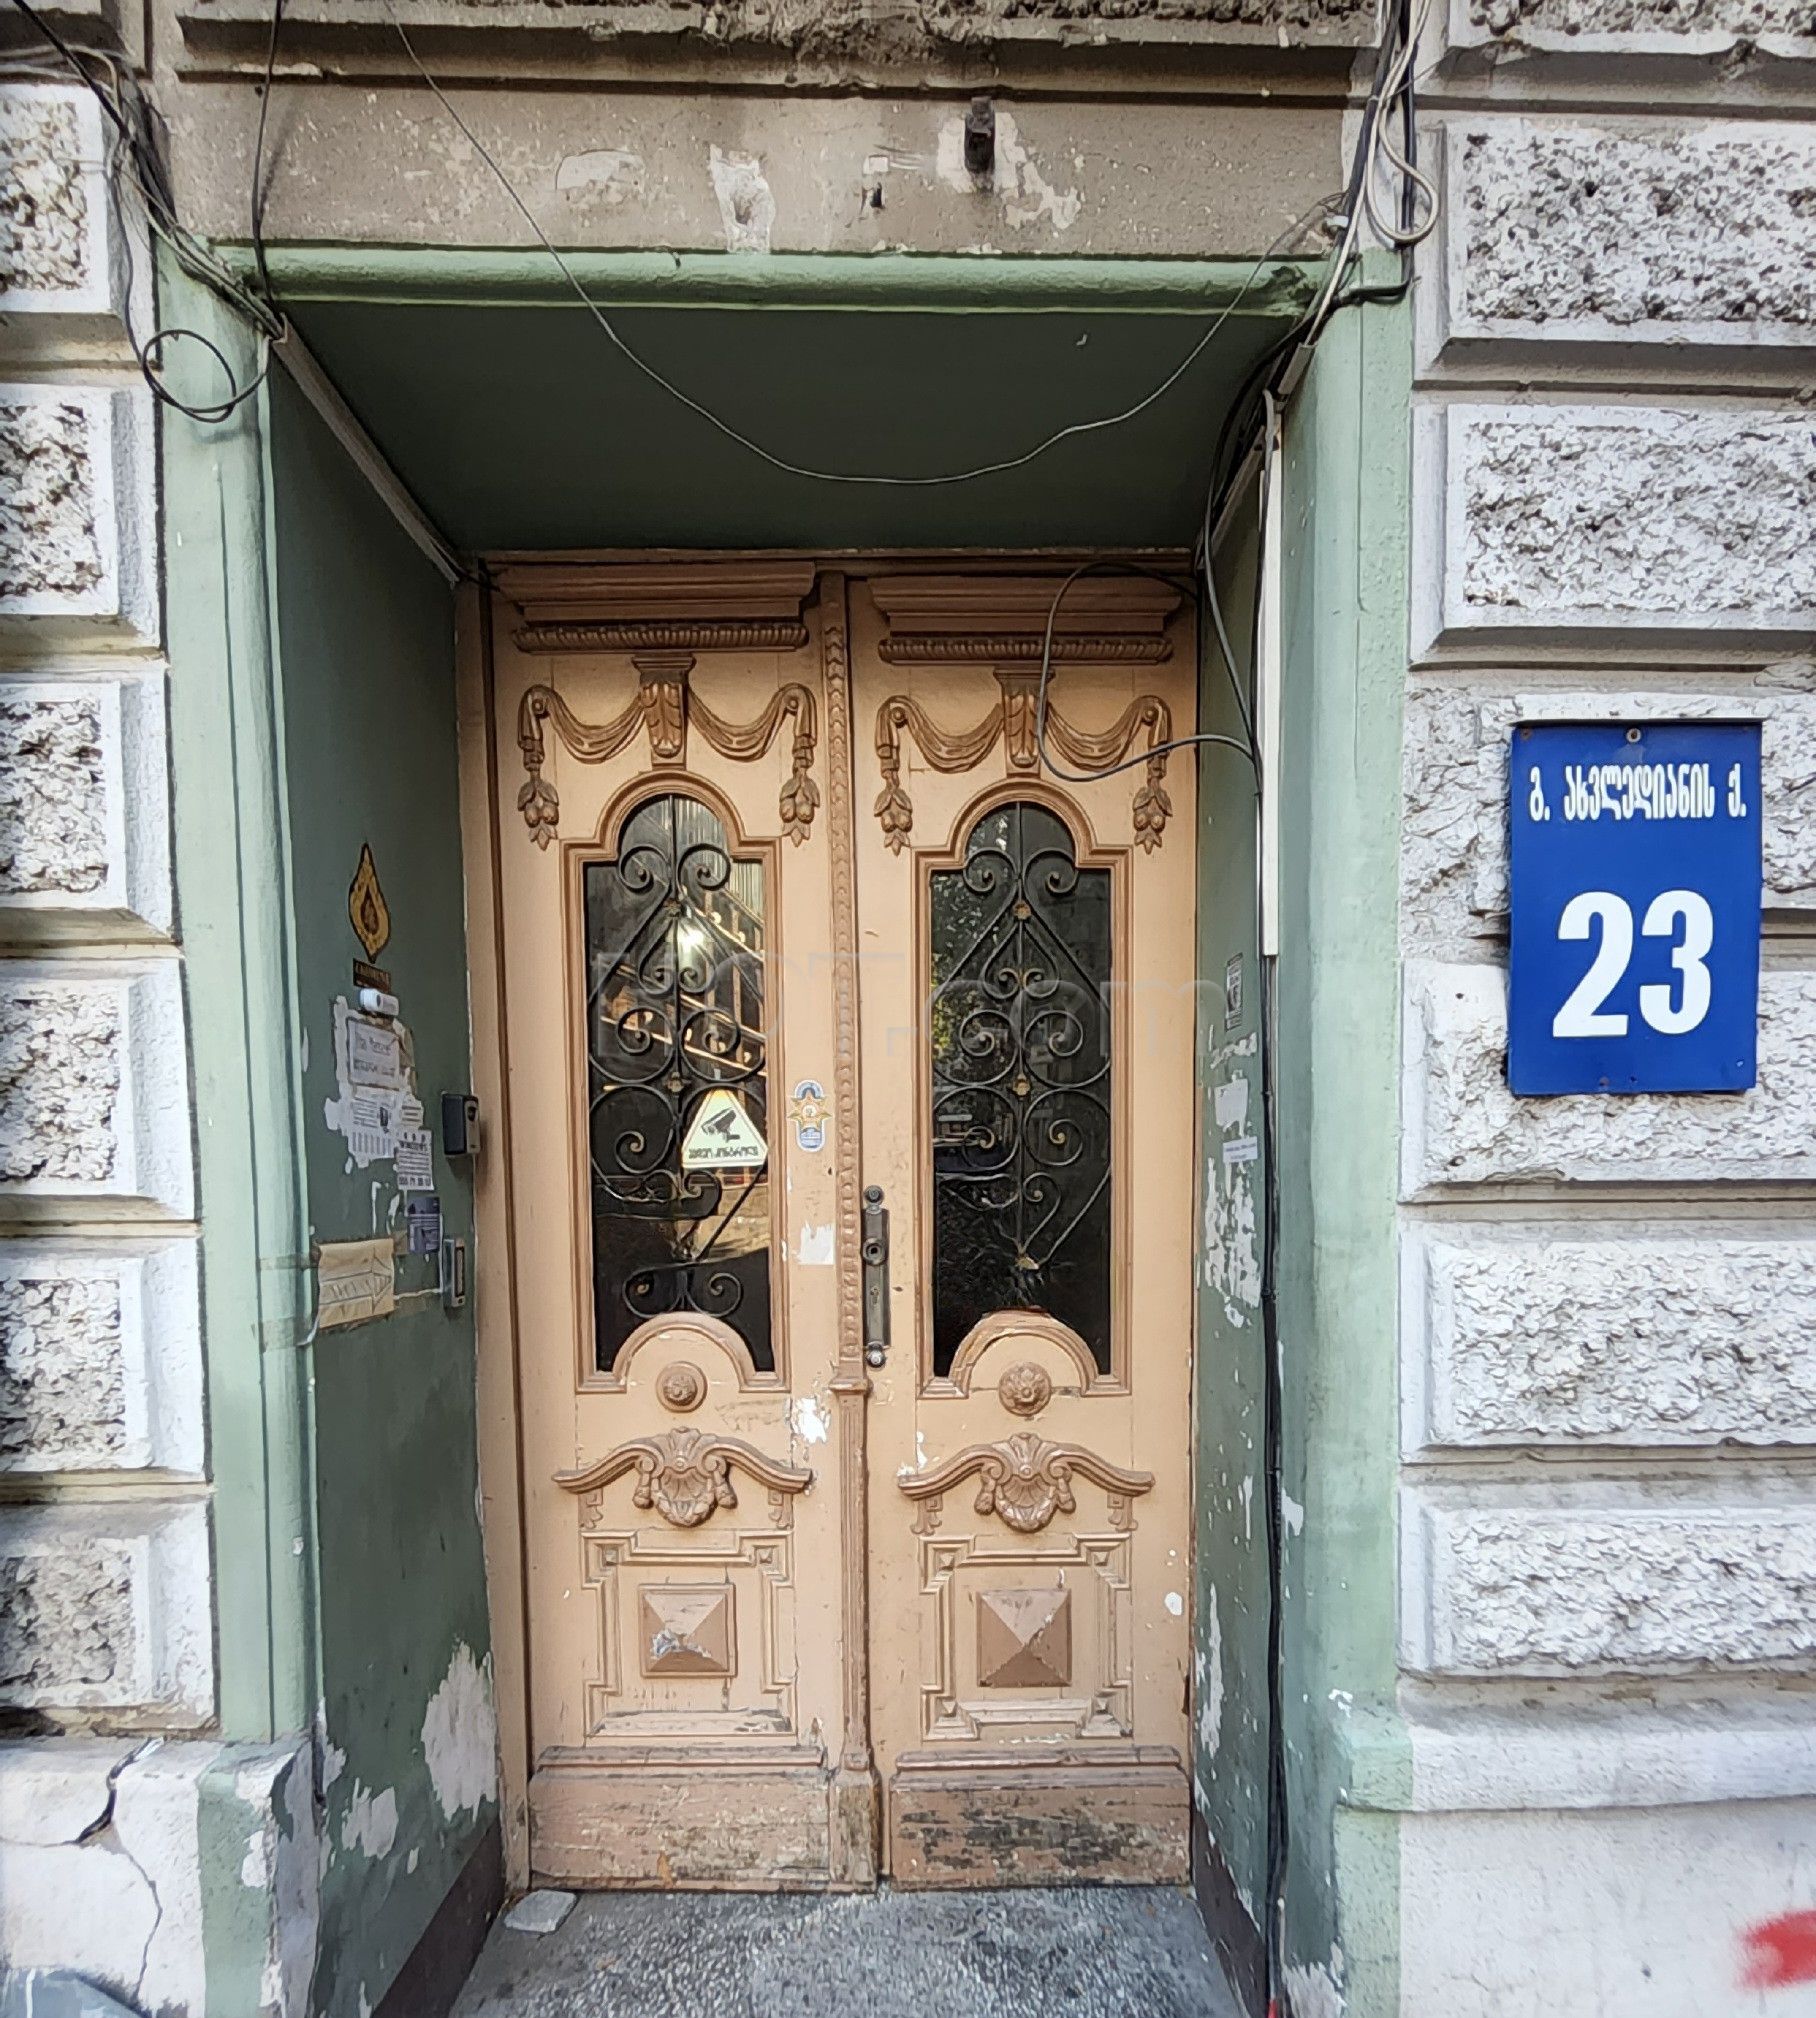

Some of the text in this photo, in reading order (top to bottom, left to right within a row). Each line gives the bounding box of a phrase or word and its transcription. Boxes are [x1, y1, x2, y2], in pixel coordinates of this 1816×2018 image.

[1529, 762, 1747, 822] გ. ახვლედიანის ქ.
[1552, 889, 1714, 1038] 23
